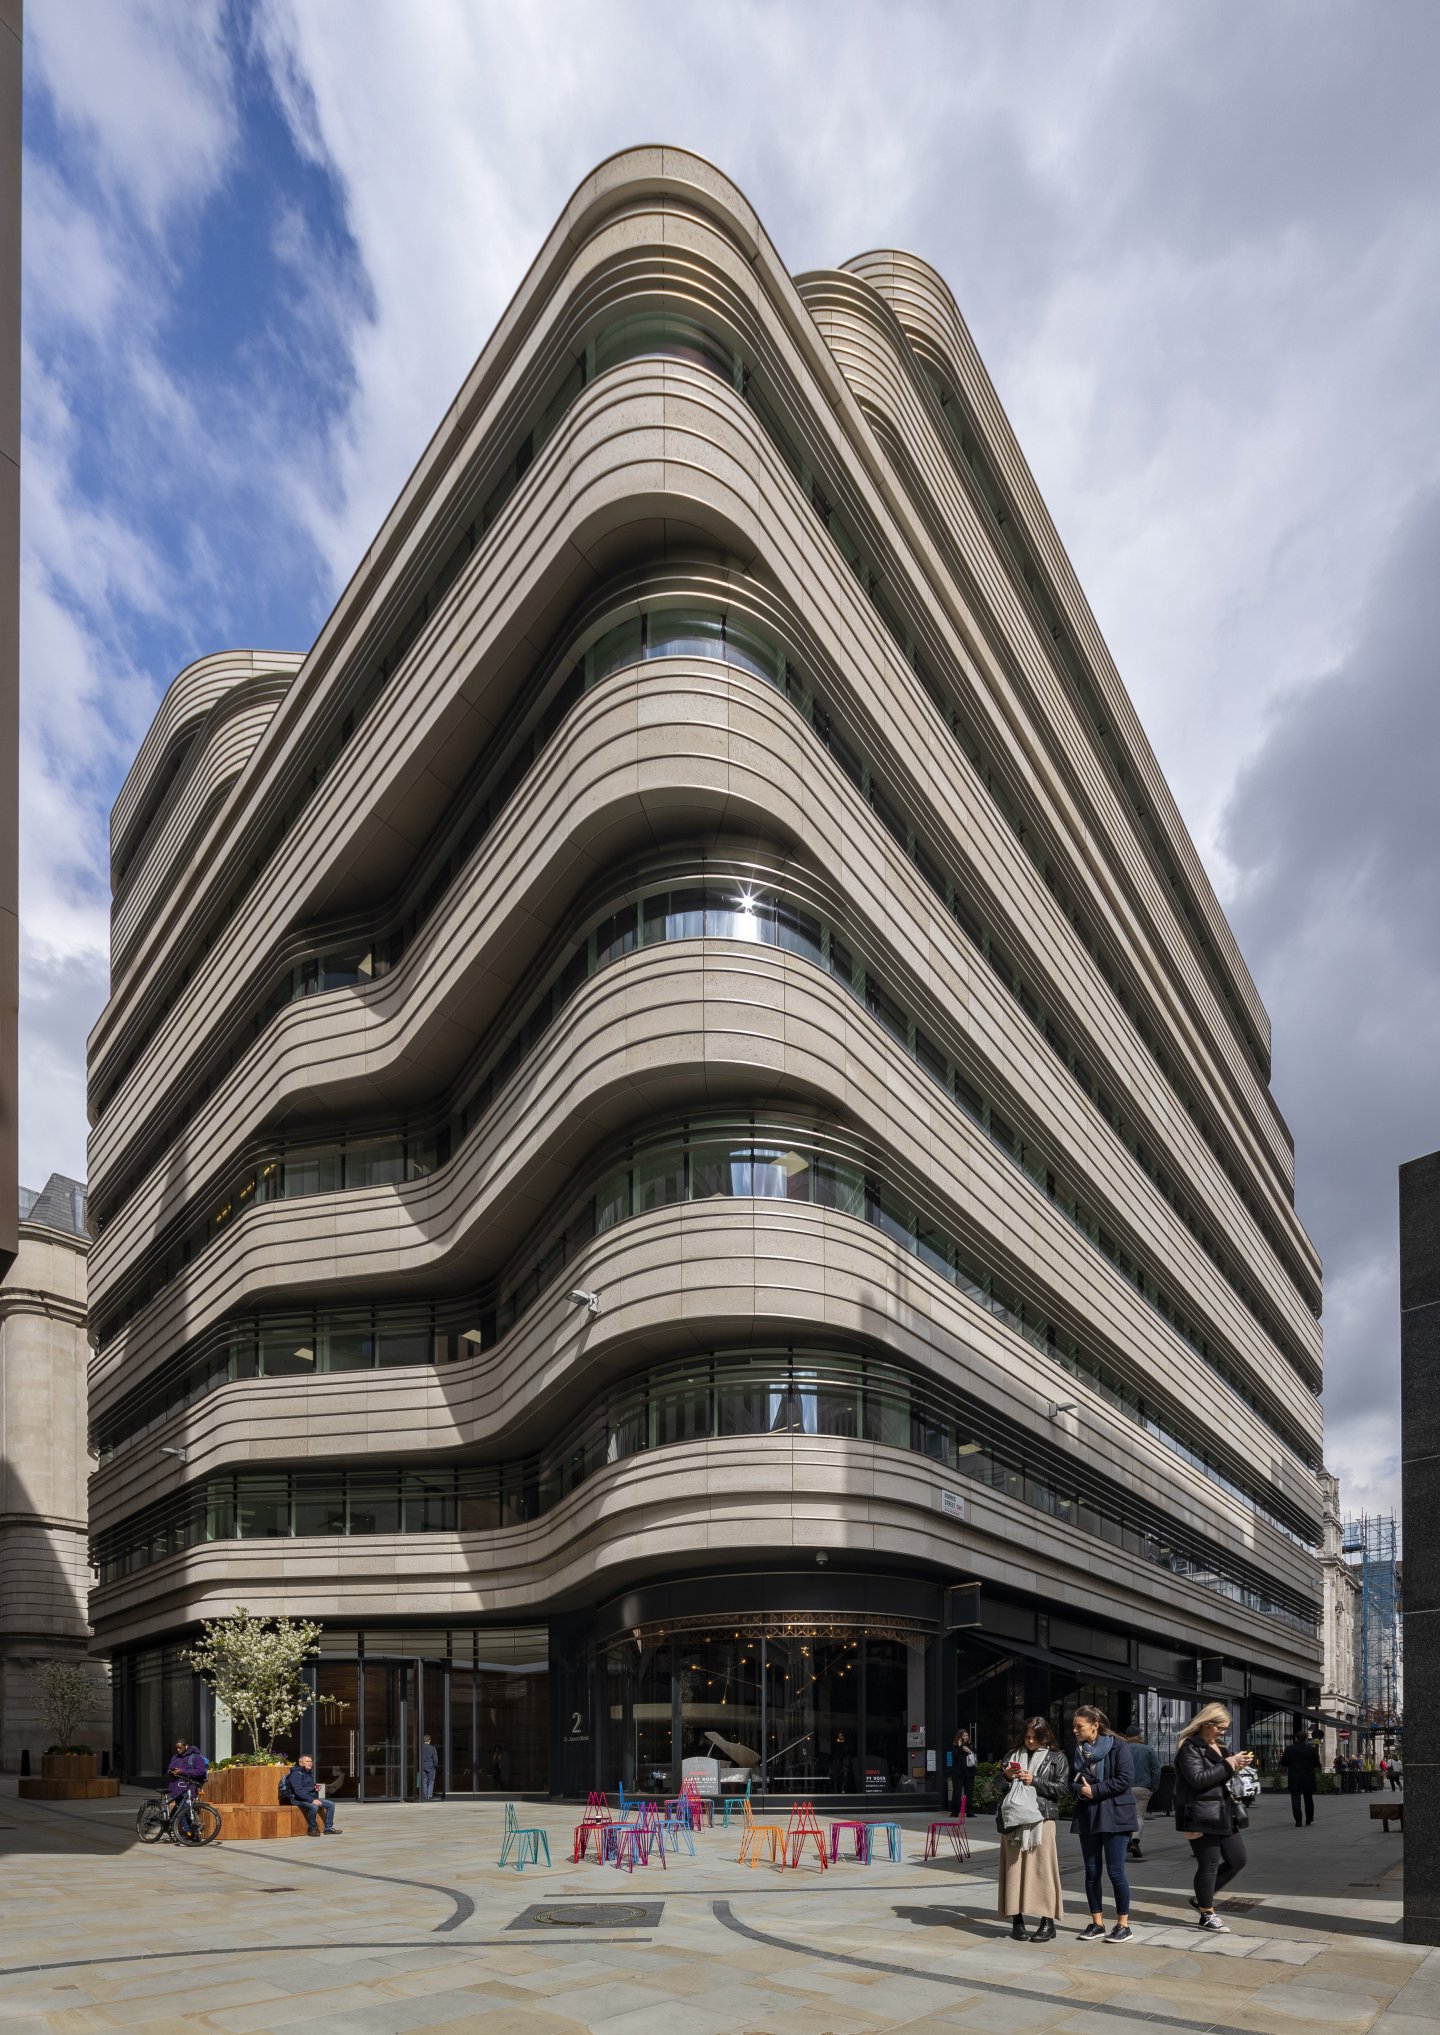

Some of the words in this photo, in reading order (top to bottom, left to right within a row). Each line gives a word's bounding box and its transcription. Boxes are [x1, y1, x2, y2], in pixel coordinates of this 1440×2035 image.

[944, 1492, 957, 1502] NORRIS
[944, 1499, 956, 1509] STREET
[572, 1712, 582, 1733] 2
